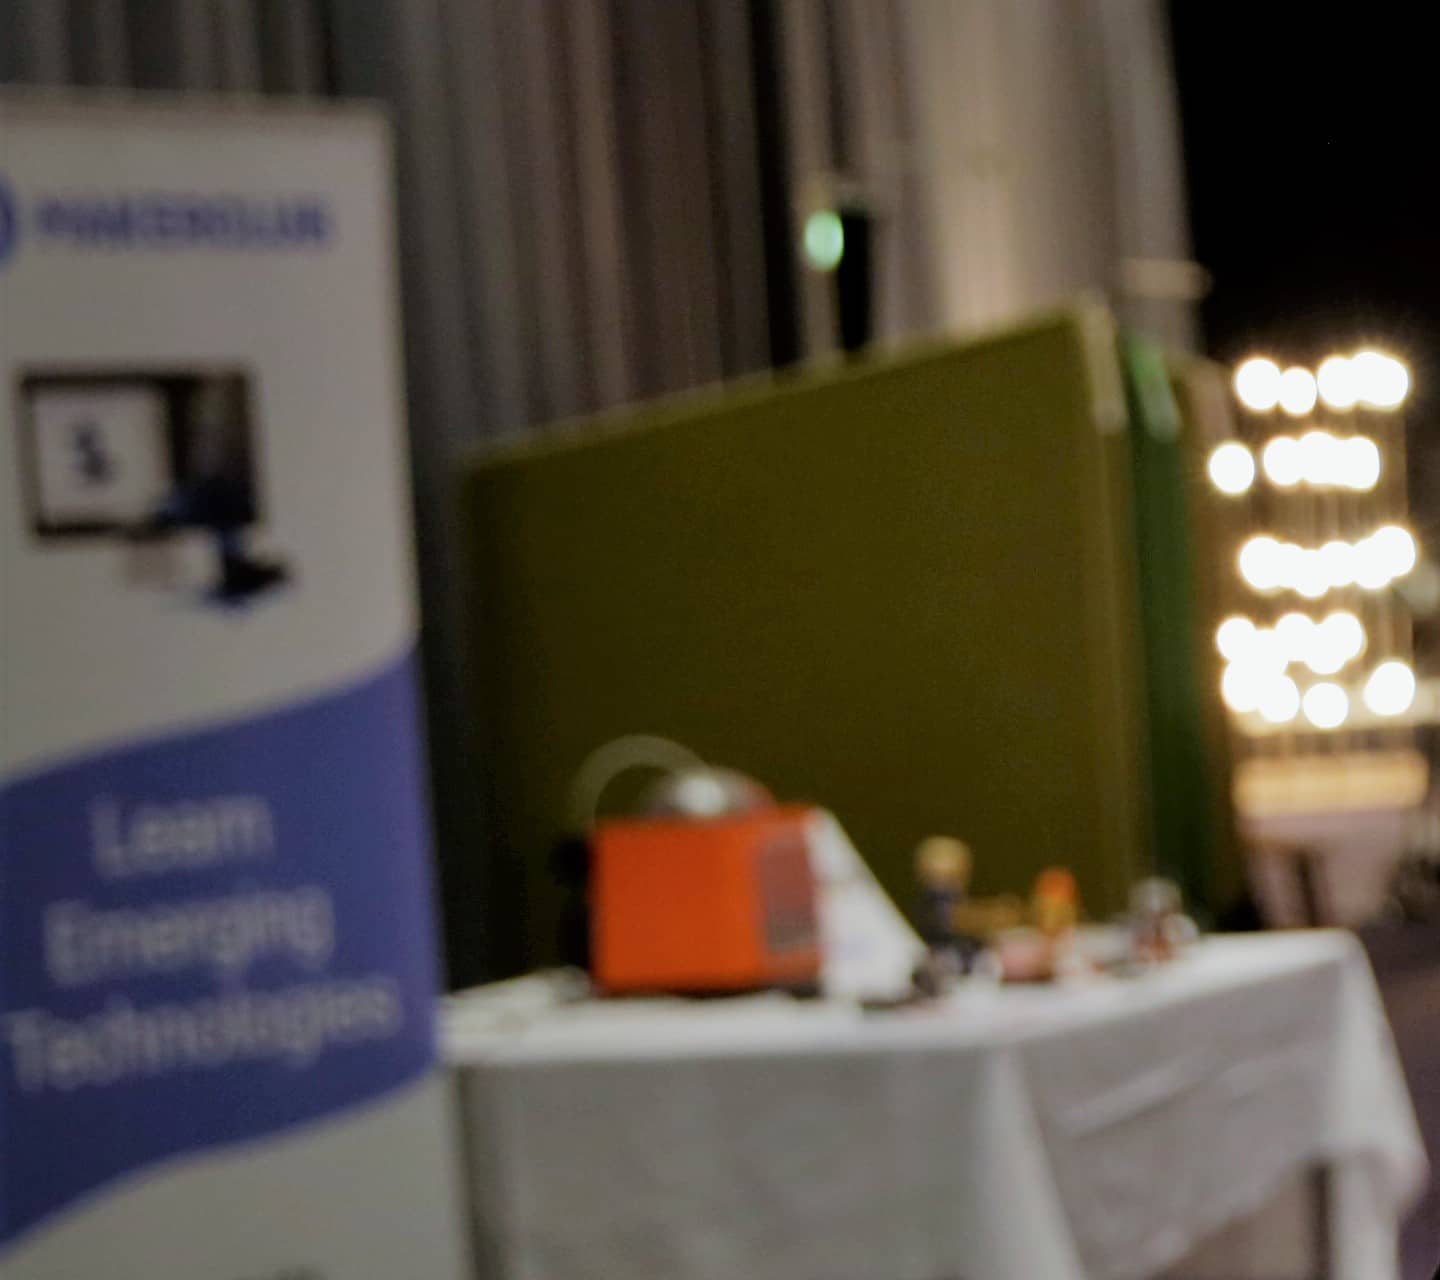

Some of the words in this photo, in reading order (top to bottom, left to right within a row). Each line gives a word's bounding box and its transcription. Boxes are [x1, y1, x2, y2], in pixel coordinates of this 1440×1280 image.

[90, 795, 274, 880] Learn
[45, 884, 334, 987] Emerging
[6, 976, 402, 1093] Technologies
